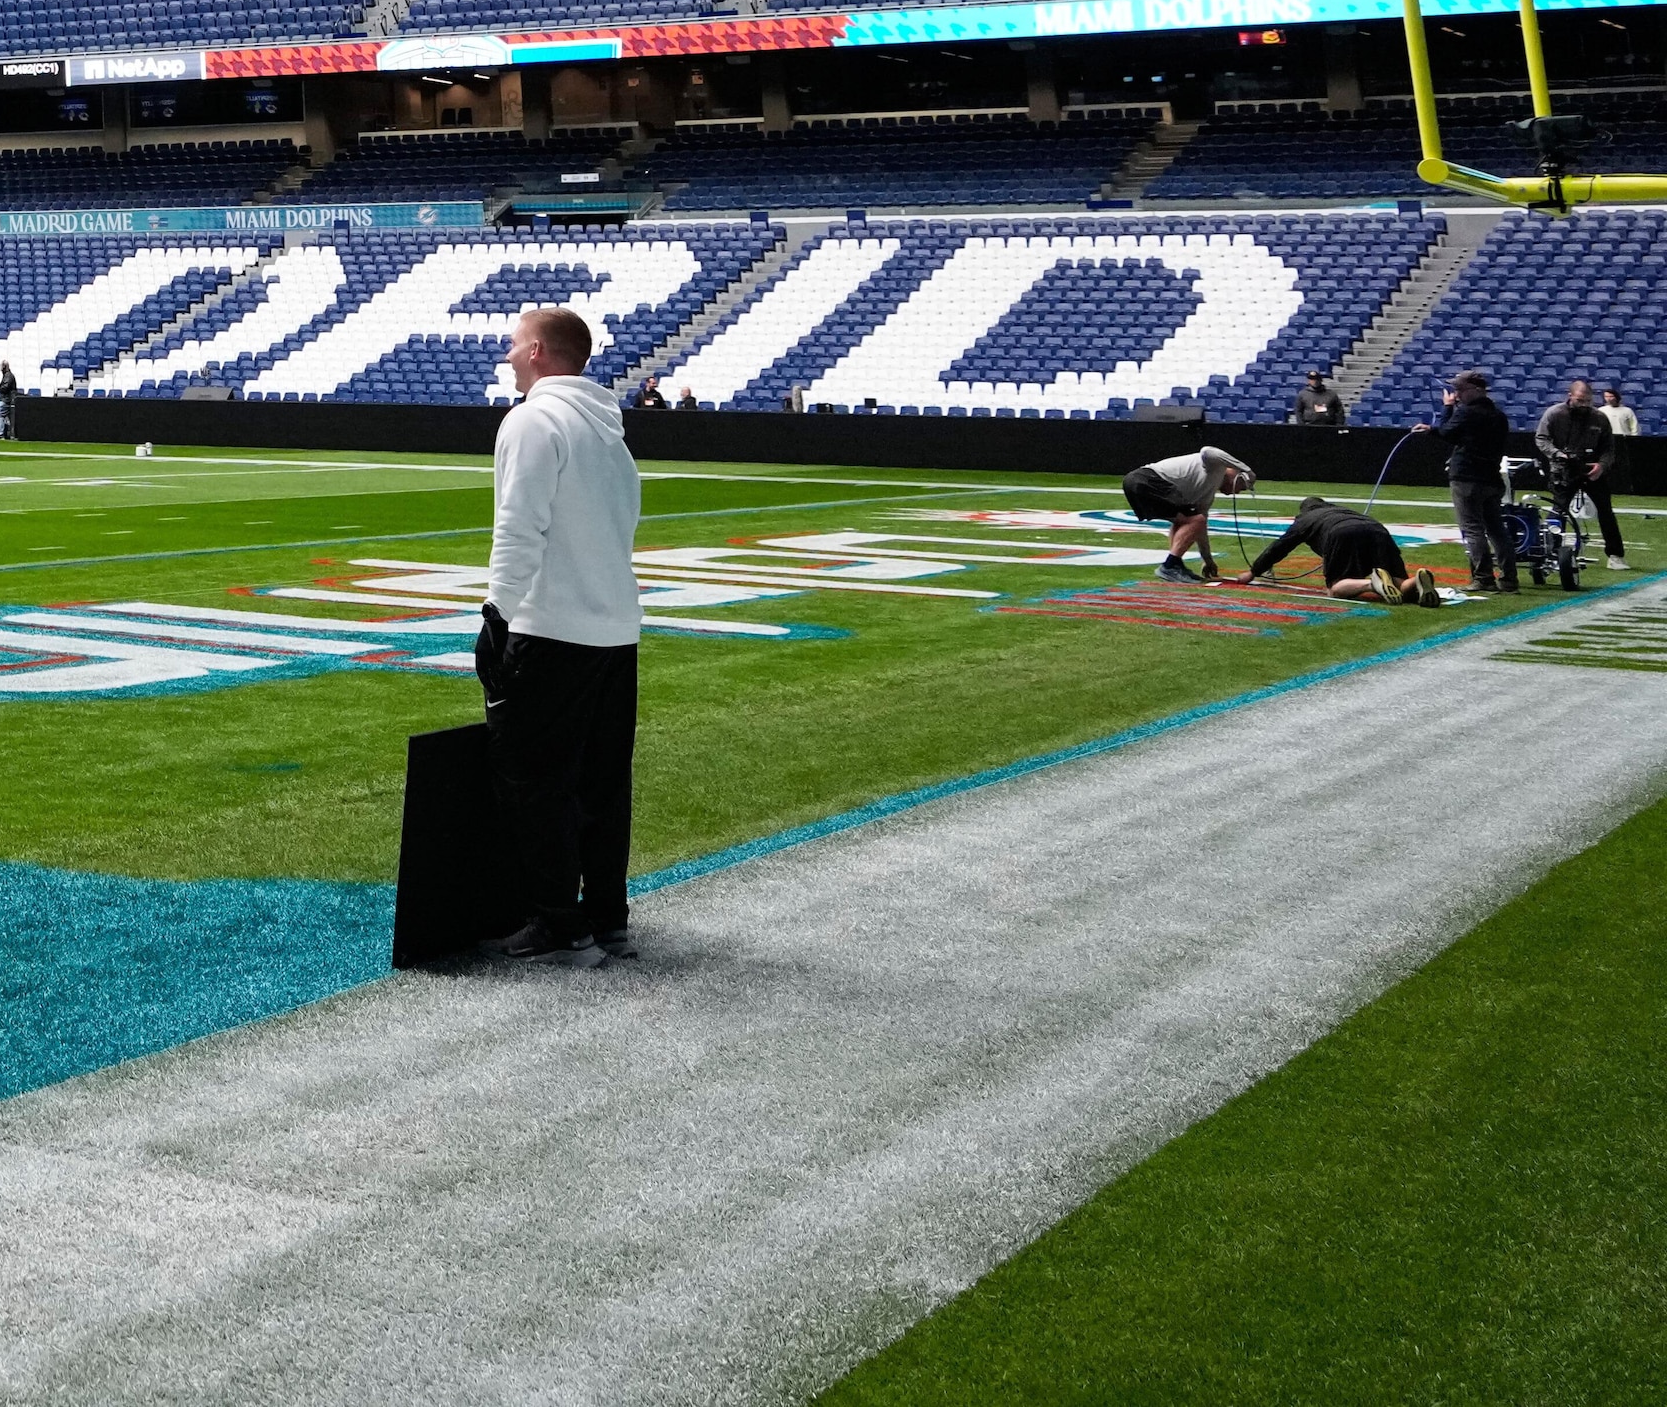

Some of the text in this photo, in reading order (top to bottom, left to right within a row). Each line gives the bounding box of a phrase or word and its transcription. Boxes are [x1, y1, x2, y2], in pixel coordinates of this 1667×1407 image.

[1035, 2, 1135, 35] MIAMI
[107, 56, 186, 81] NetApp
[9, 214, 78, 233] MADRID
[81, 213, 133, 232] GAME
[226, 208, 373, 230] MIAMI DOLPHINS
